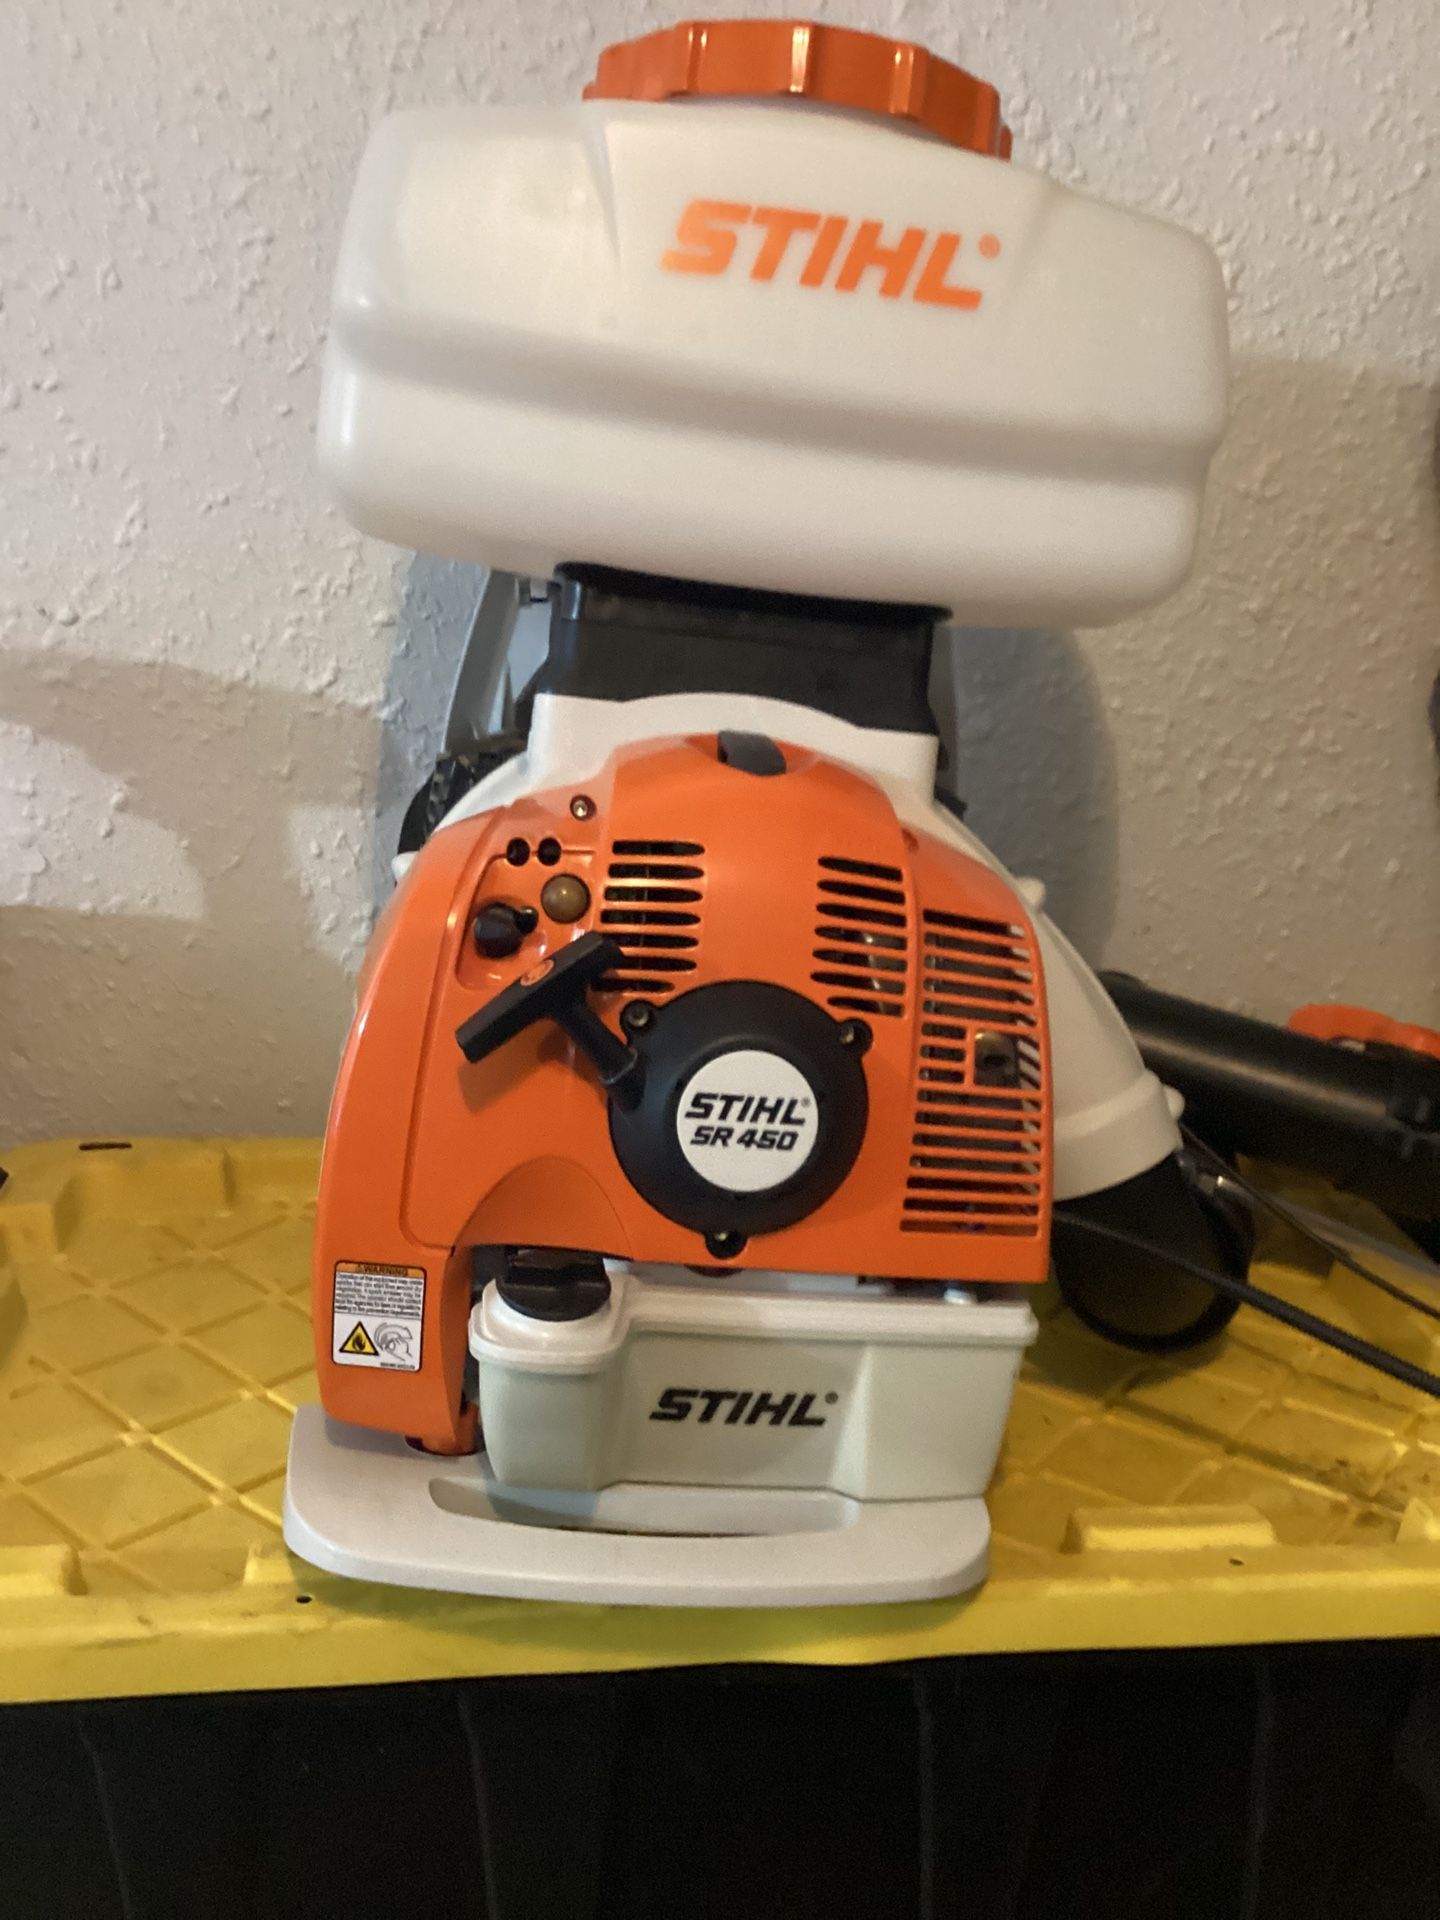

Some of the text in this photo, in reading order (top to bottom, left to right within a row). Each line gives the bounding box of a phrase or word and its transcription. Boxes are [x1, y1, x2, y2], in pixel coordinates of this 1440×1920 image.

[660, 198, 983, 311] STIHL
[685, 1092, 806, 1127] STIHL
[690, 1125, 799, 1151] SR 450
[363, 1264, 408, 1276] WARNING
[649, 1388, 826, 1426] STIHL
